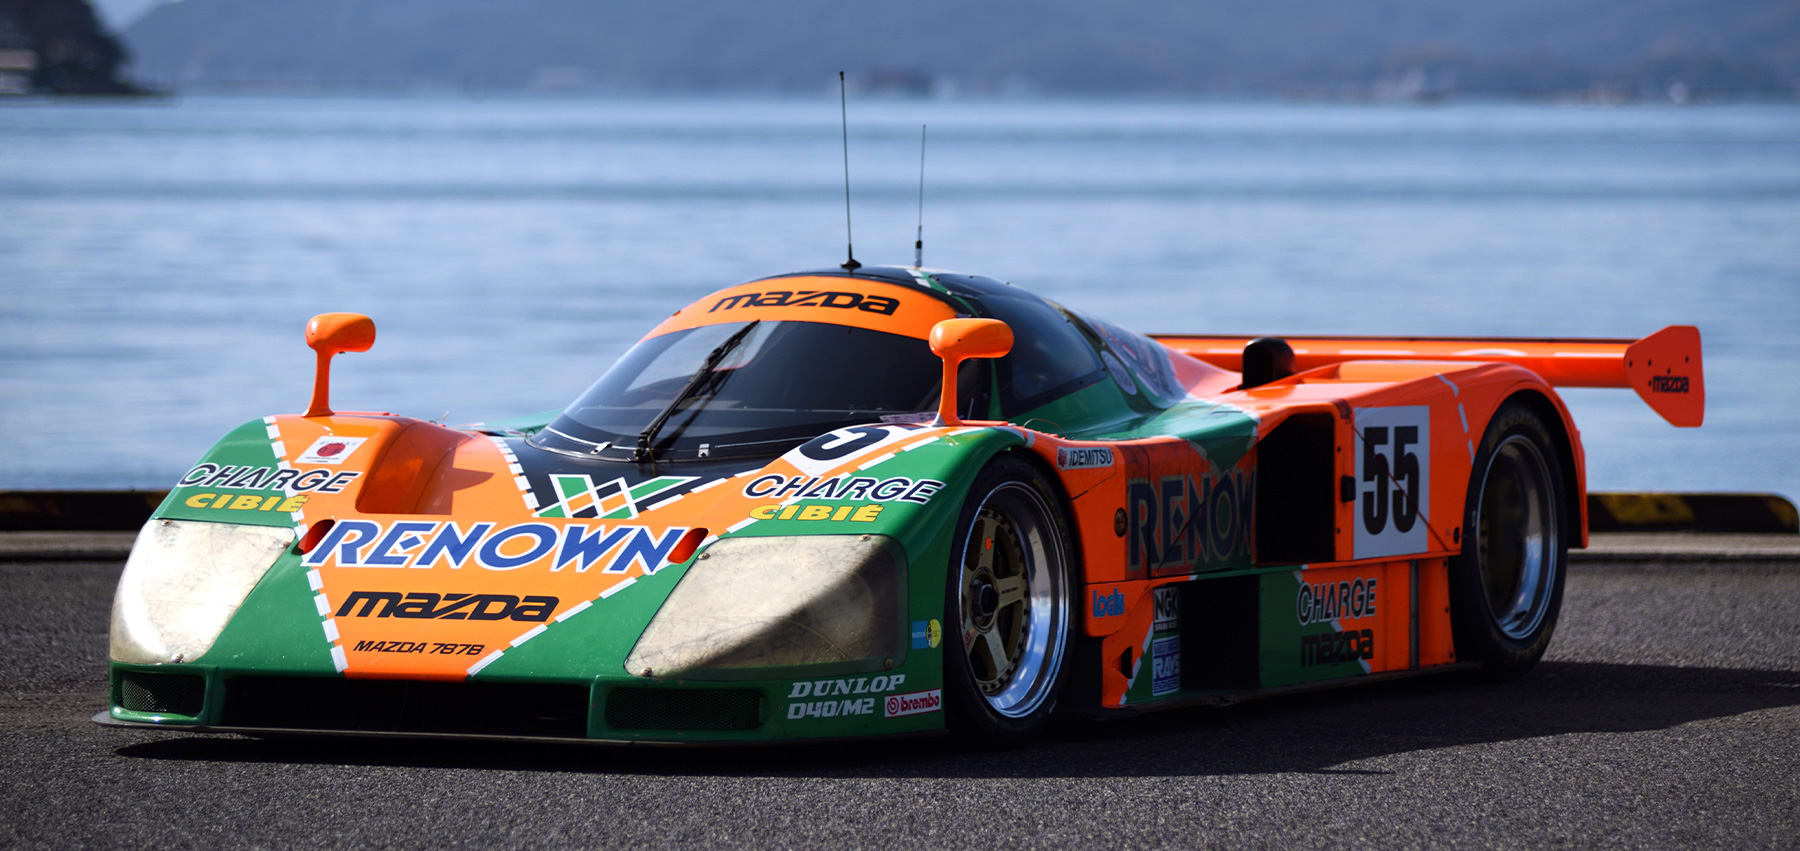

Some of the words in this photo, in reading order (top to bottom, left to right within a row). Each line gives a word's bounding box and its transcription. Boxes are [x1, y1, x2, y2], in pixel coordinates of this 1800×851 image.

[1069, 449, 1113, 466] IDEMITSU
[178, 464, 361, 493] CHARGE
[743, 474, 947, 504] CHARGE
[1363, 426, 1420, 535] 55
[185, 493, 310, 512] CIBIÉ
[749, 504, 884, 522] CIBIÉ
[1127, 468, 1257, 571] RENOW
[301, 520, 690, 575] RENOWN
[1154, 588, 1178, 621] NGK
[1296, 577, 1378, 626] CHARGE
[353, 640, 427, 653] MAZDA
[429, 642, 485, 655] 787B
[787, 674, 906, 698] DUNLOP
[787, 698, 875, 720] D40/M2
[900, 693, 940, 712] brembo
